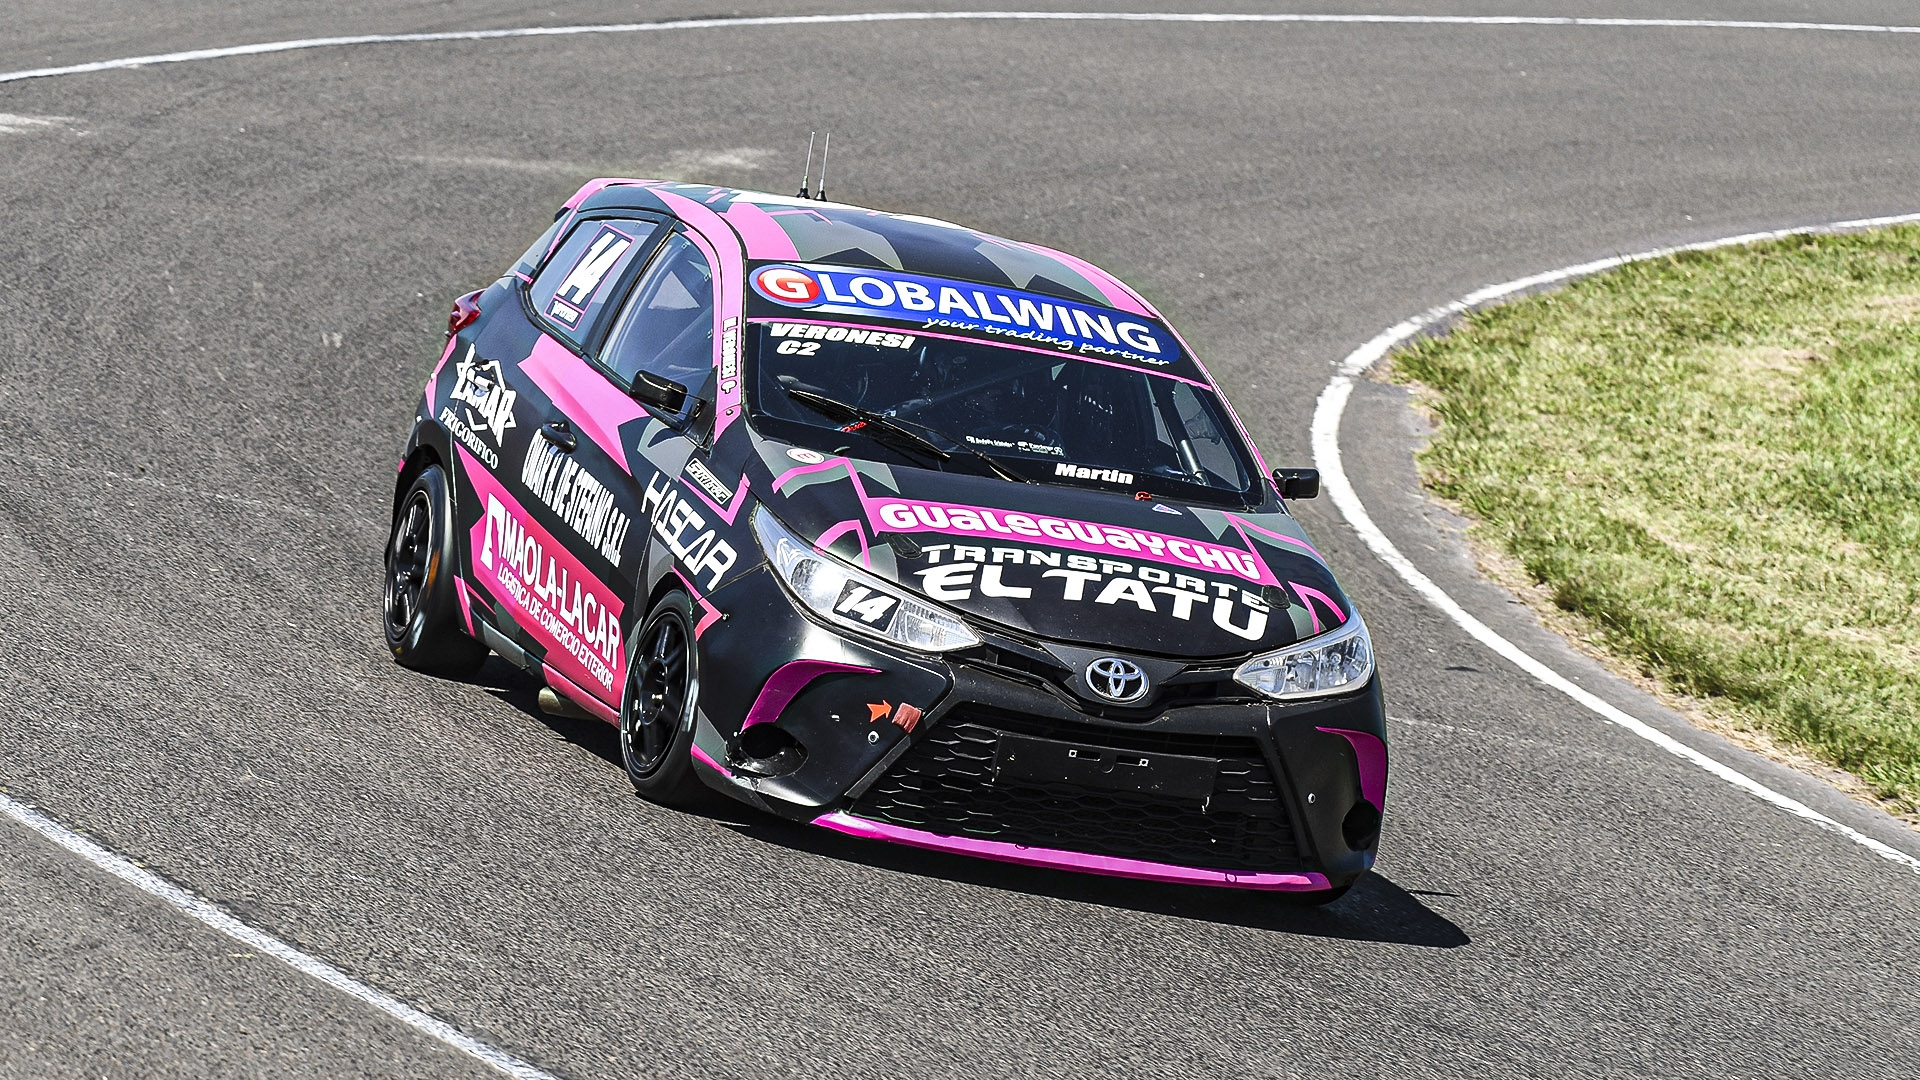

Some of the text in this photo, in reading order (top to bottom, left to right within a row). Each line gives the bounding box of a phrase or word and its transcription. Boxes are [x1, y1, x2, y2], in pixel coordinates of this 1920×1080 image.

[556, 231, 632, 305] 14
[763, 268, 1161, 354] GLOBALWING
[769, 323, 916, 349] VERONESI
[776, 339, 822, 357] C2
[922, 317, 1170, 366] your trading partner
[439, 406, 499, 470] FRIGORIFICO
[1055, 462, 1134, 485] Martin
[564, 467, 615, 550] STEFANO
[835, 585, 898, 624] 14
[912, 562, 1032, 601] EL
[921, 543, 1270, 613] TRANSPORTE
[497, 562, 614, 692] LOGISTICA DE COMERCIO EXTERIOR
